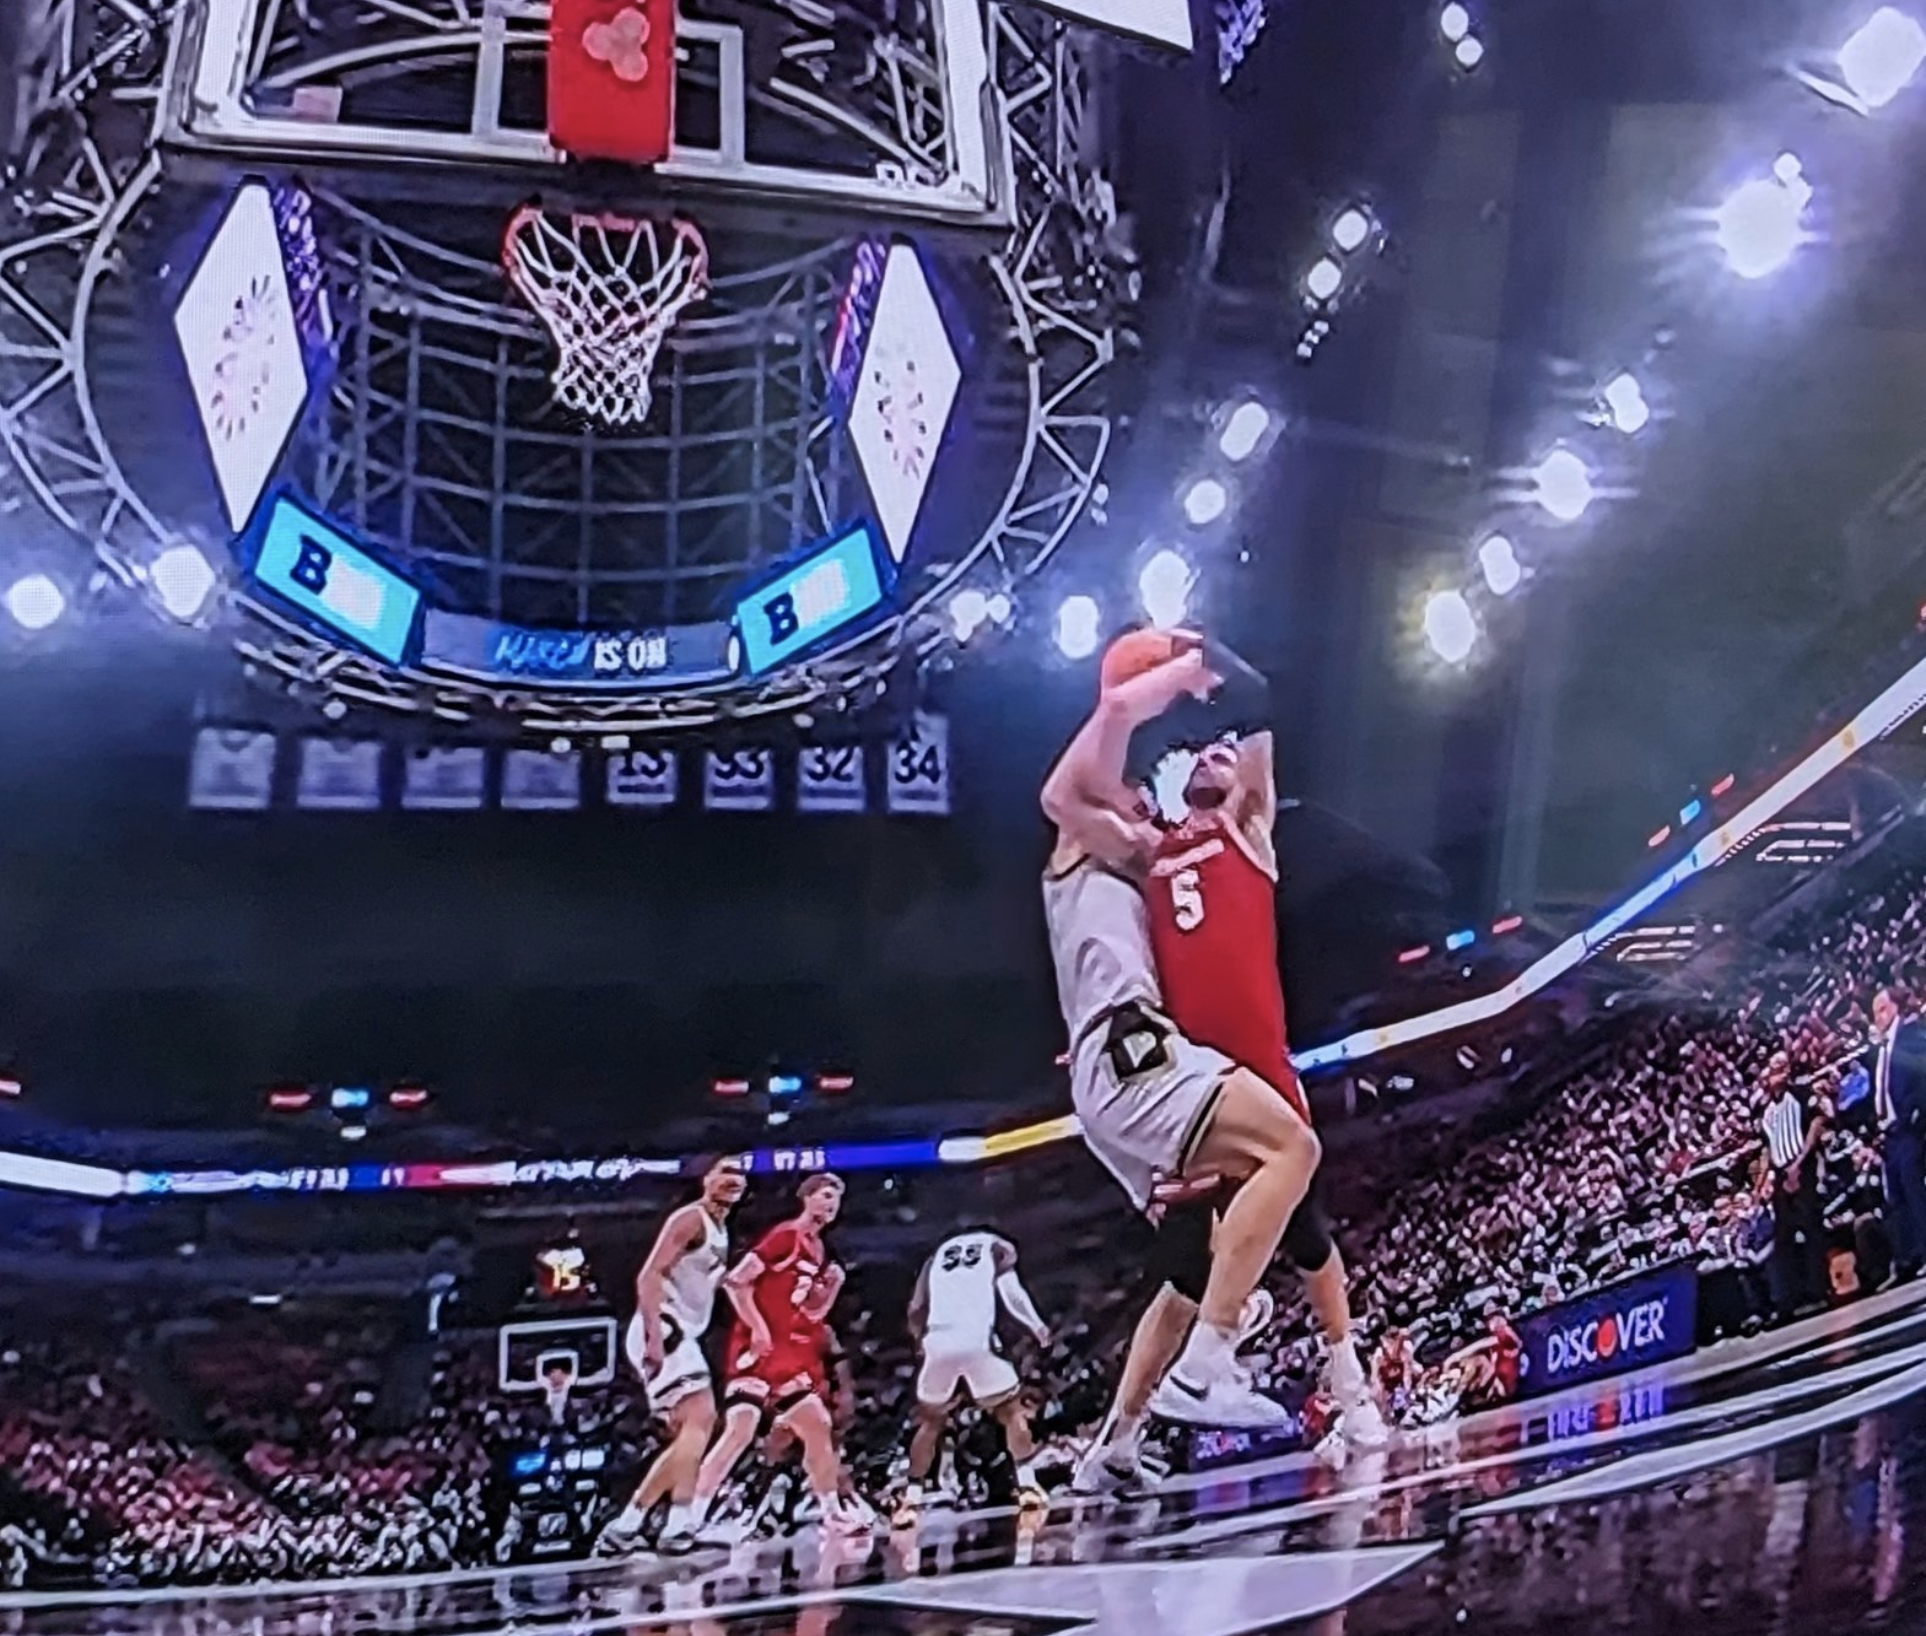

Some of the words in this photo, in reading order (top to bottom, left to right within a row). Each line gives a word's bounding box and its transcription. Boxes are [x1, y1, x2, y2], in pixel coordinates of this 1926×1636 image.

[289, 533, 332, 595] B
[764, 591, 798, 646] B
[594, 637, 623, 670] IS
[628, 636, 667, 670] ON
[895, 740, 940, 784] 34
[1171, 868, 1204, 931] 5
[1547, 1299, 1665, 1374] DISCOVER
